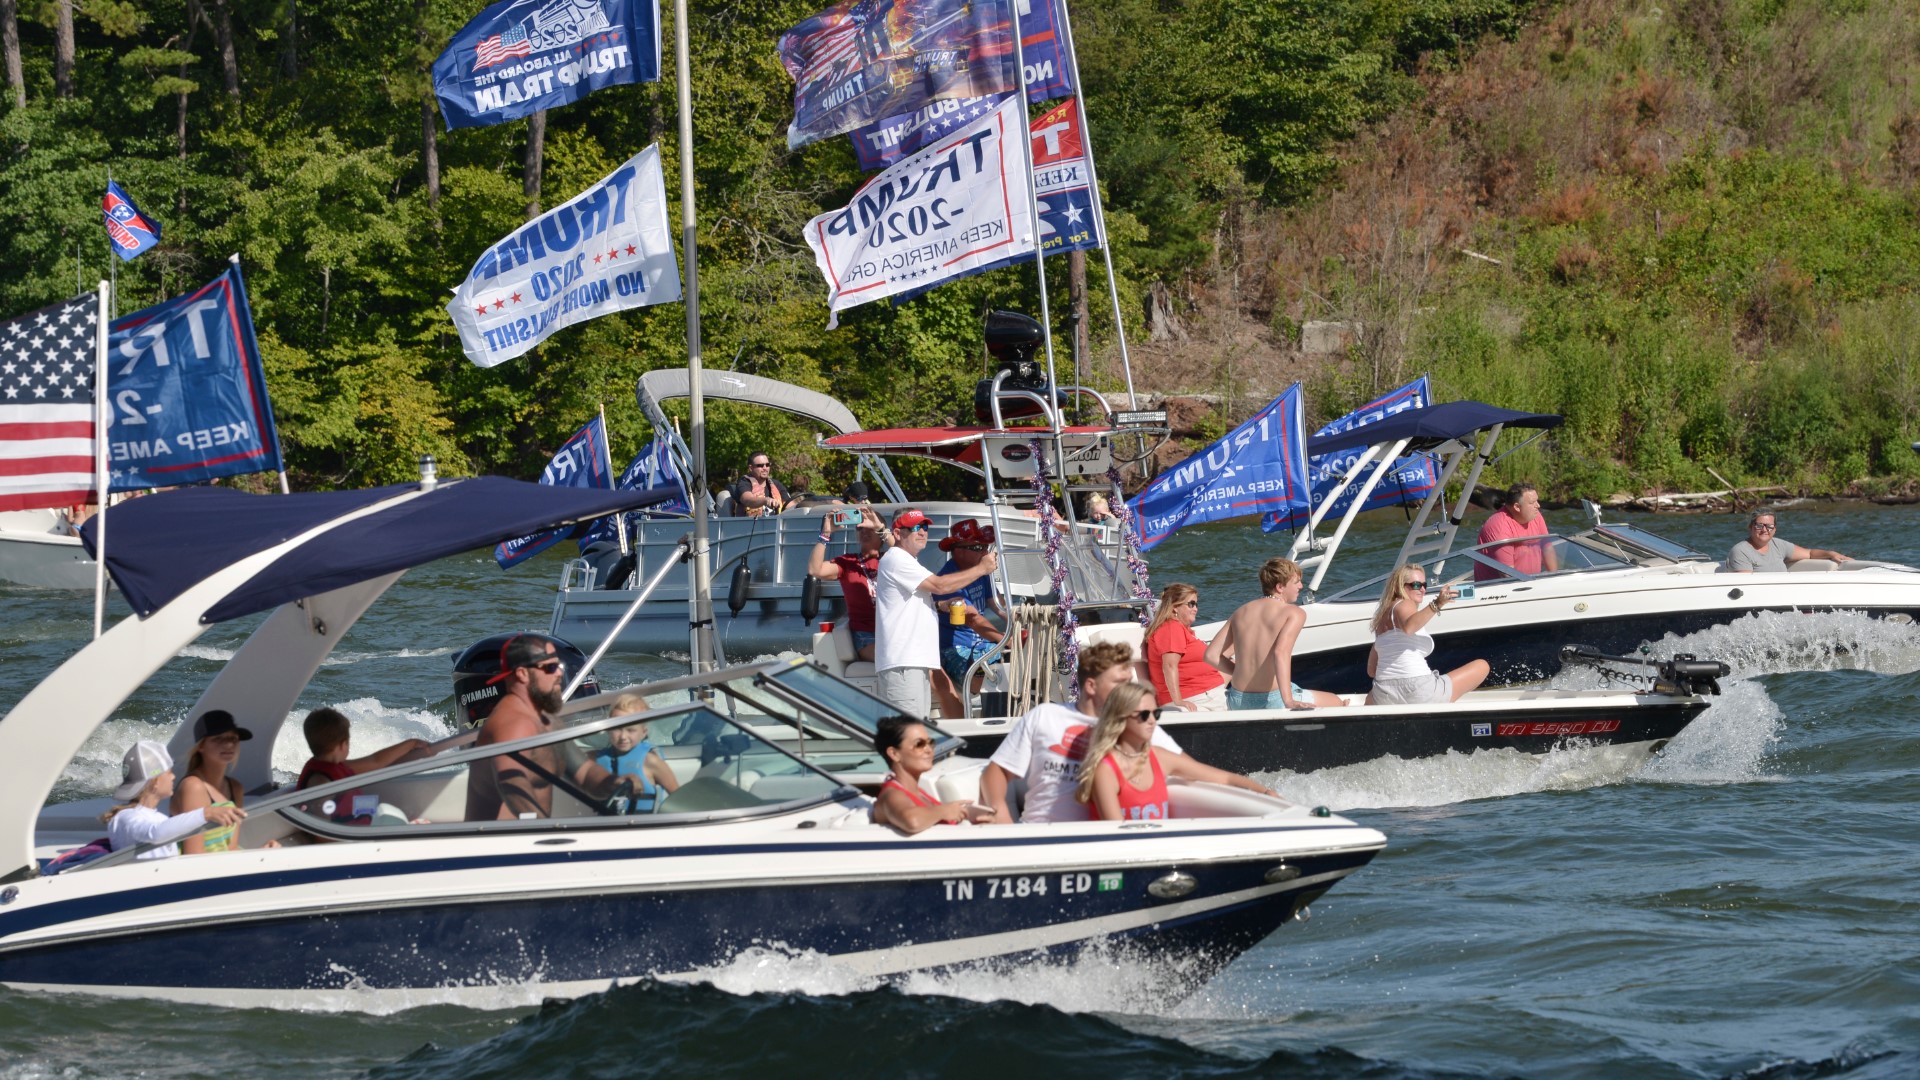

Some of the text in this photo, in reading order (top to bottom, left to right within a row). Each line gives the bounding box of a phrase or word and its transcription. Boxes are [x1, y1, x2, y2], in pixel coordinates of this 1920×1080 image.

[106, 217, 140, 250] TRUMP
[466, 686, 498, 703] YAMAHA
[1043, 760, 1070, 774] CALM
[943, 873, 1092, 900] TN 7184 ED
[1102, 879, 1119, 890] 19
